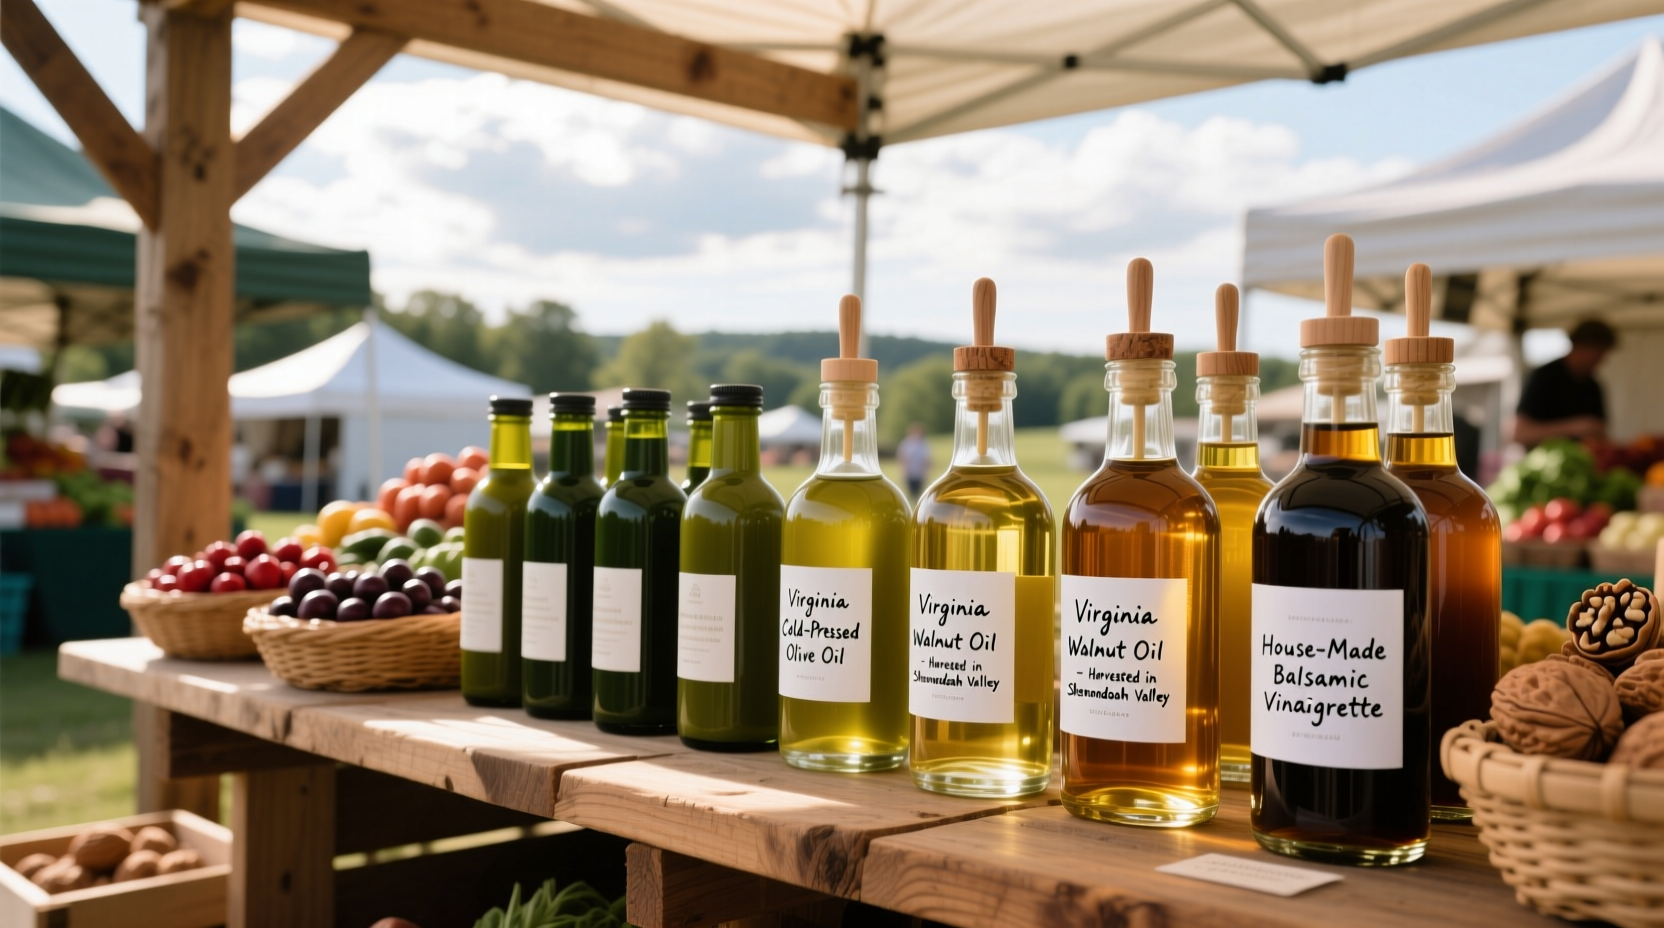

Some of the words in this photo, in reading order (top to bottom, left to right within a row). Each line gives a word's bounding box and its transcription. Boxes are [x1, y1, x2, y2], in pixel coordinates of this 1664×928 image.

[788, 588, 850, 618] Virginia
[919, 593, 990, 627] Virginia
[782, 618, 860, 640] Cold-Pressed
[1075, 598, 1158, 636] Virginia
[913, 628, 964, 651] Walnut
[969, 631, 997, 652] Oil
[1068, 635, 1127, 660] Walnut
[1133, 639, 1164, 661] Oil
[1262, 633, 1387, 661] House-Made
[786, 643, 815, 663] Olive
[821, 646, 845, 665] Oil
[972, 661, 982, 672] in
[967, 675, 1000, 693] Valley
[1145, 671, 1157, 684] in
[1273, 663, 1369, 689] Balsamic
[1134, 687, 1170, 708] Valley
[1264, 691, 1384, 727] Vinaigrette
